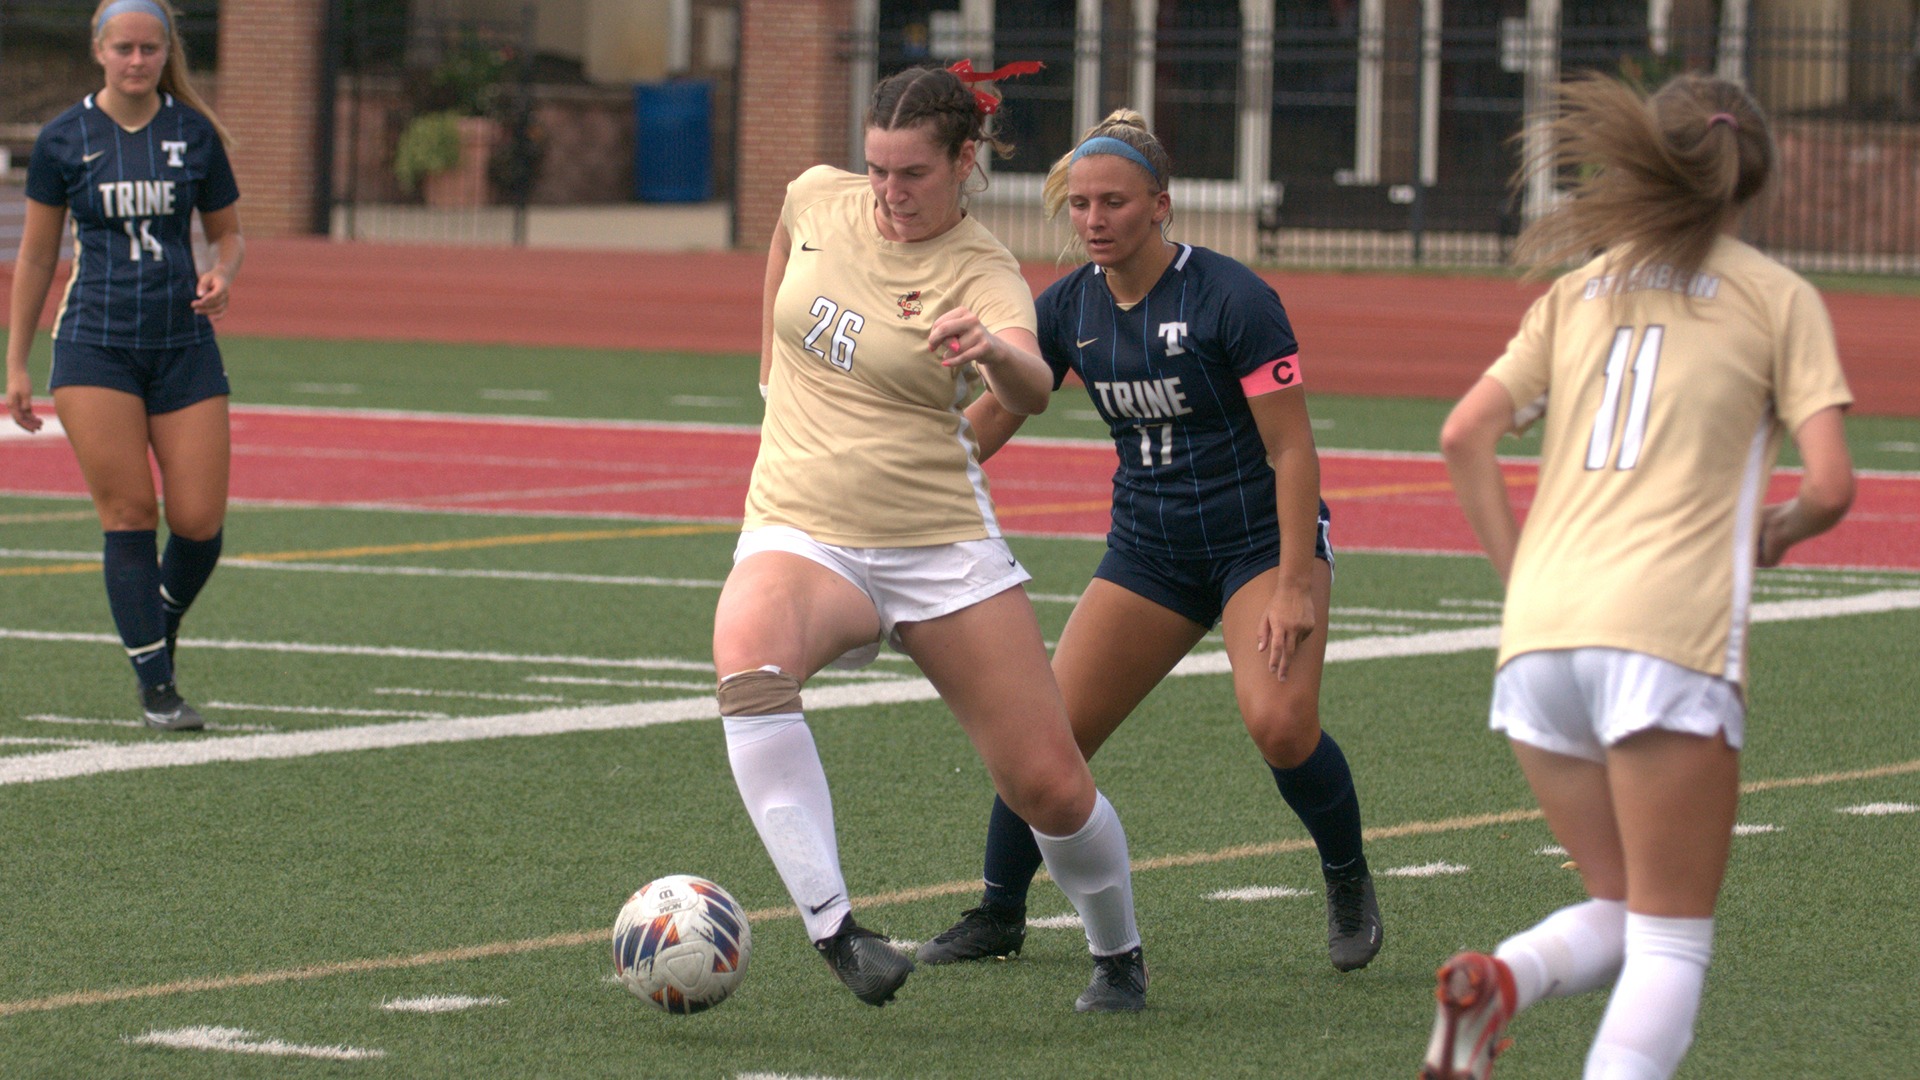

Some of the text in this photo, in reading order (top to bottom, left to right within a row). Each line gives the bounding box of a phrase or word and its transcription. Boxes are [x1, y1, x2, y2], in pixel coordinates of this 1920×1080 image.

[161, 141, 187, 167] T
[98, 181, 176, 218] TRINE
[803, 296, 865, 372] 26
[1158, 322, 1188, 357] T
[1272, 361, 1294, 384] C
[1094, 376, 1193, 418] TRINE
[1584, 324, 1665, 471] 11
